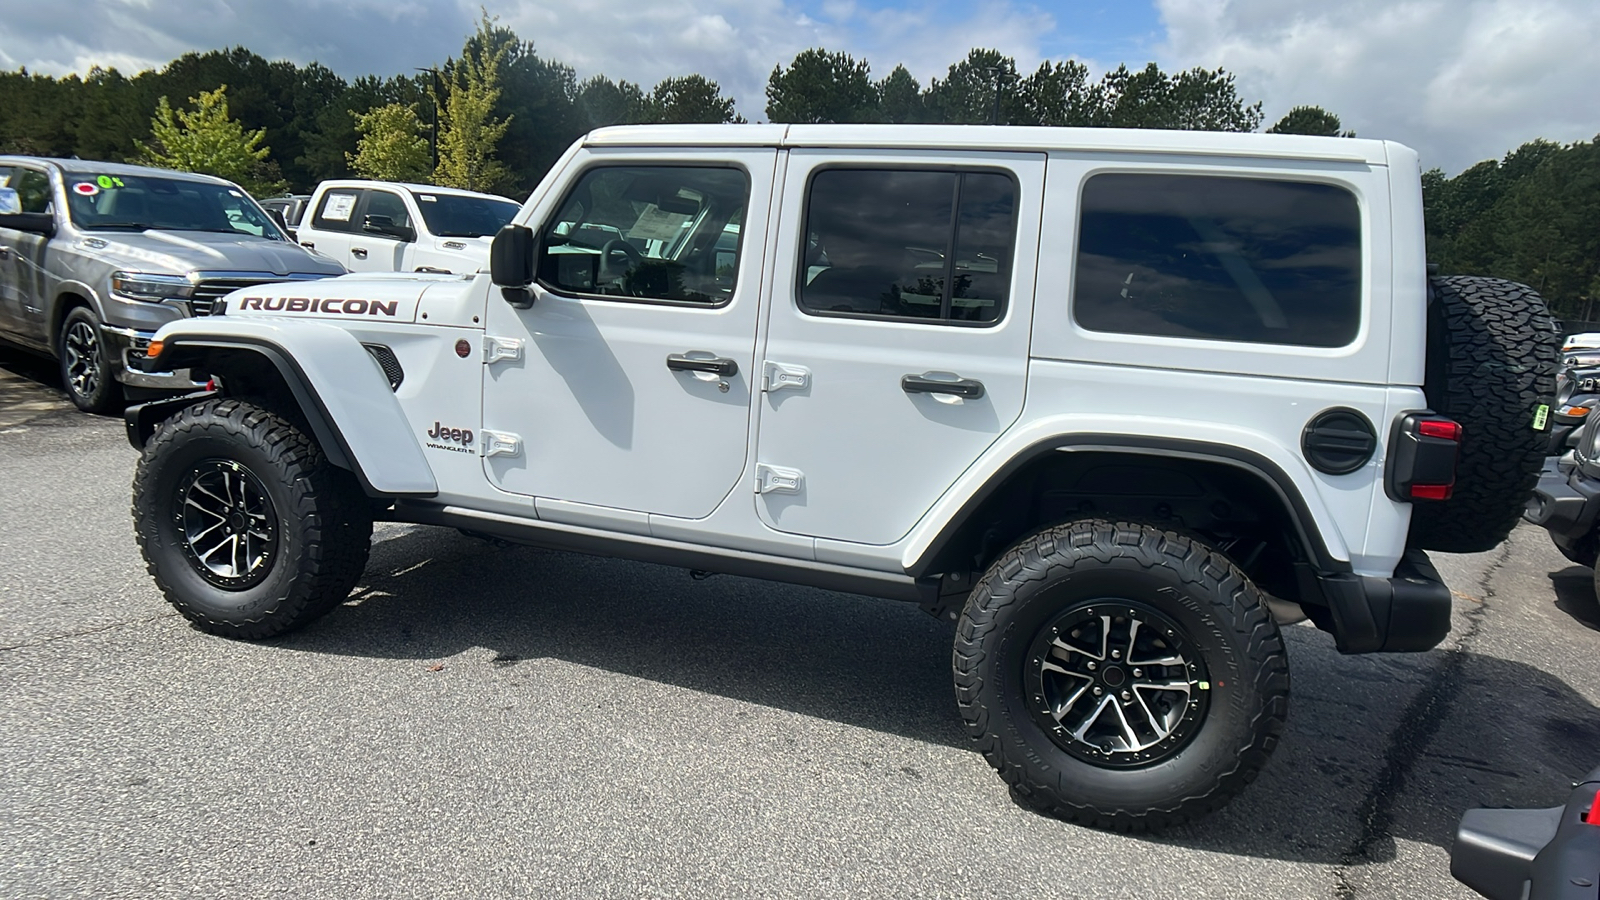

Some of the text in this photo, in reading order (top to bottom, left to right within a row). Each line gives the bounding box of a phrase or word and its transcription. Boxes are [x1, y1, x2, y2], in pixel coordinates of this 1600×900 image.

[240, 297, 398, 316] RUBICON
[428, 421, 474, 446] Jeep
[426, 442, 468, 454] WRANGLER
